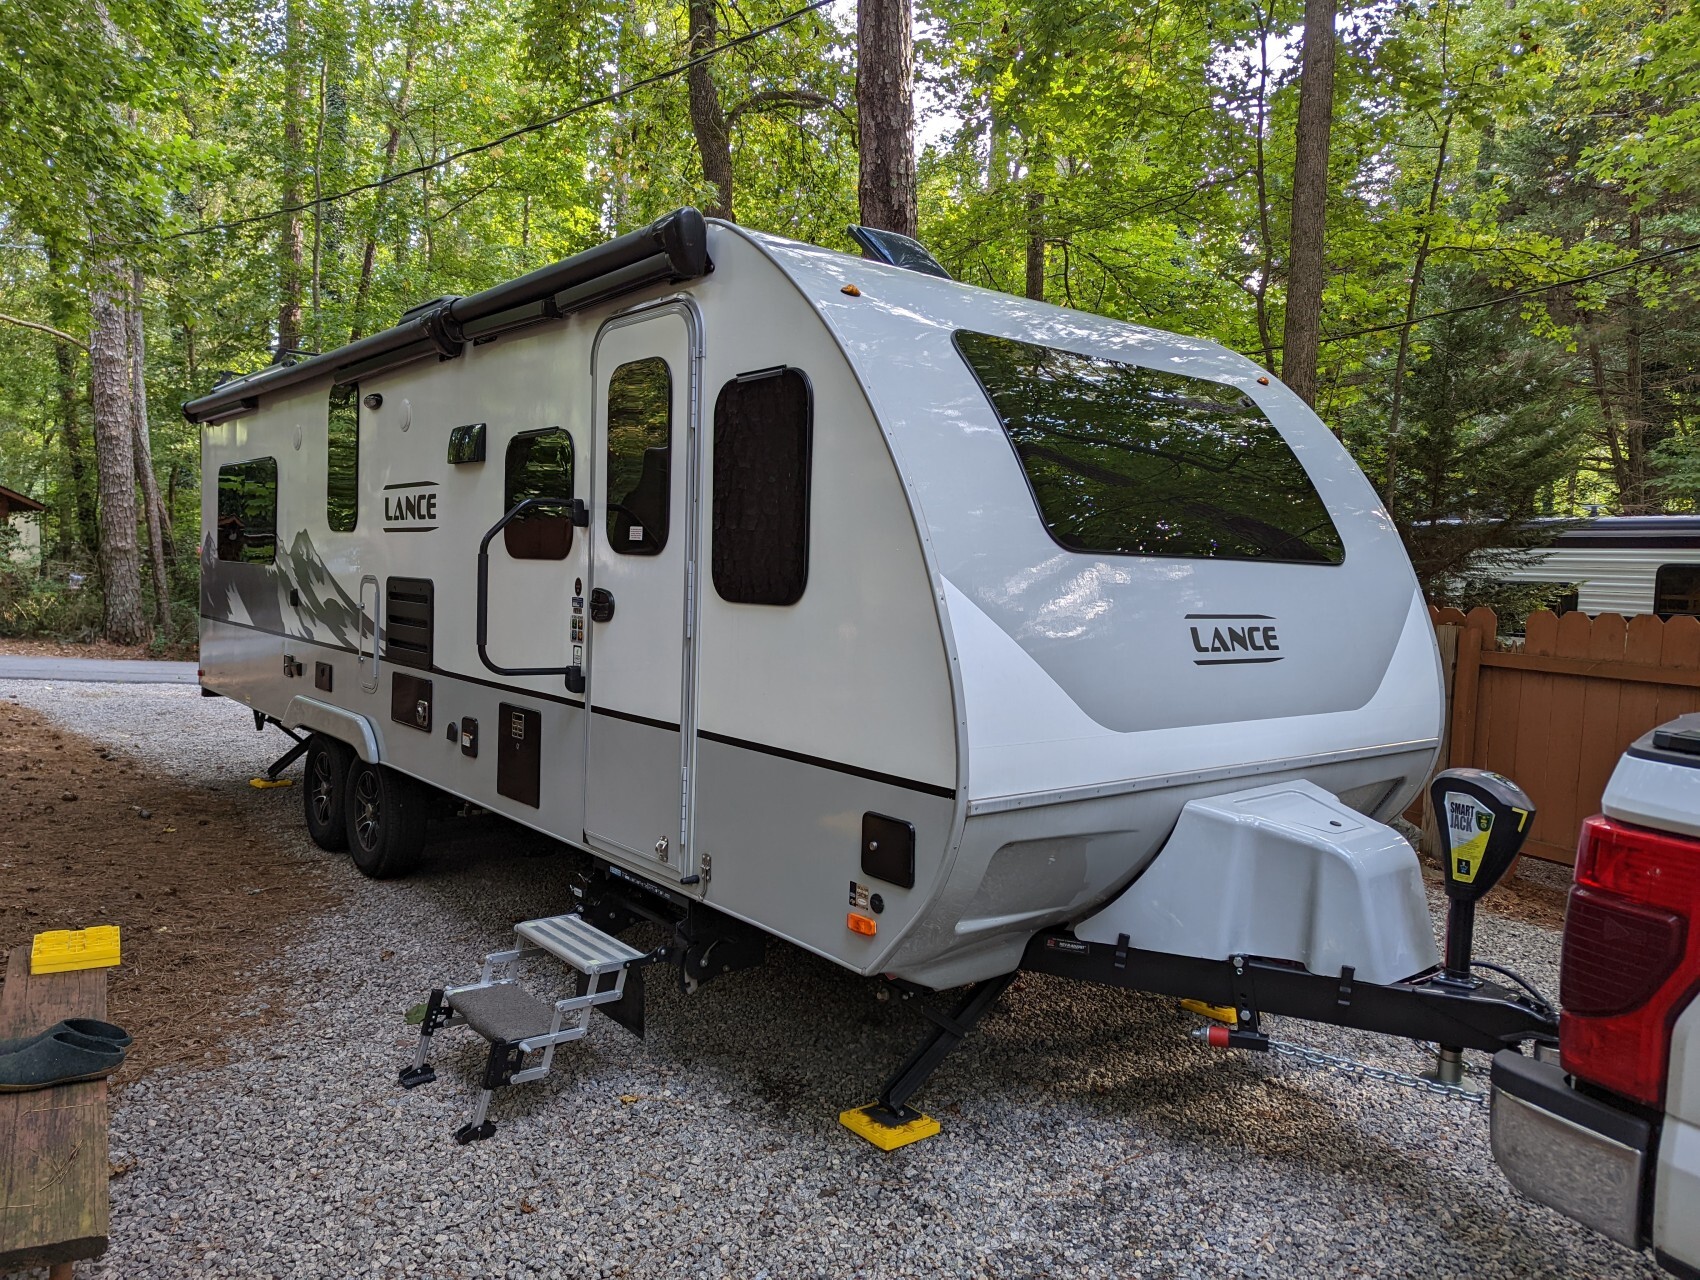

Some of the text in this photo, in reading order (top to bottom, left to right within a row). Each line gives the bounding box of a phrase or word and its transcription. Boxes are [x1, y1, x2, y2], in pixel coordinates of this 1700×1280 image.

[385, 493, 437, 521] LANCE
[1190, 626, 1280, 653] LANCE
[1450, 801, 1475, 818] SMART
[1450, 813, 1473, 832] JACK
